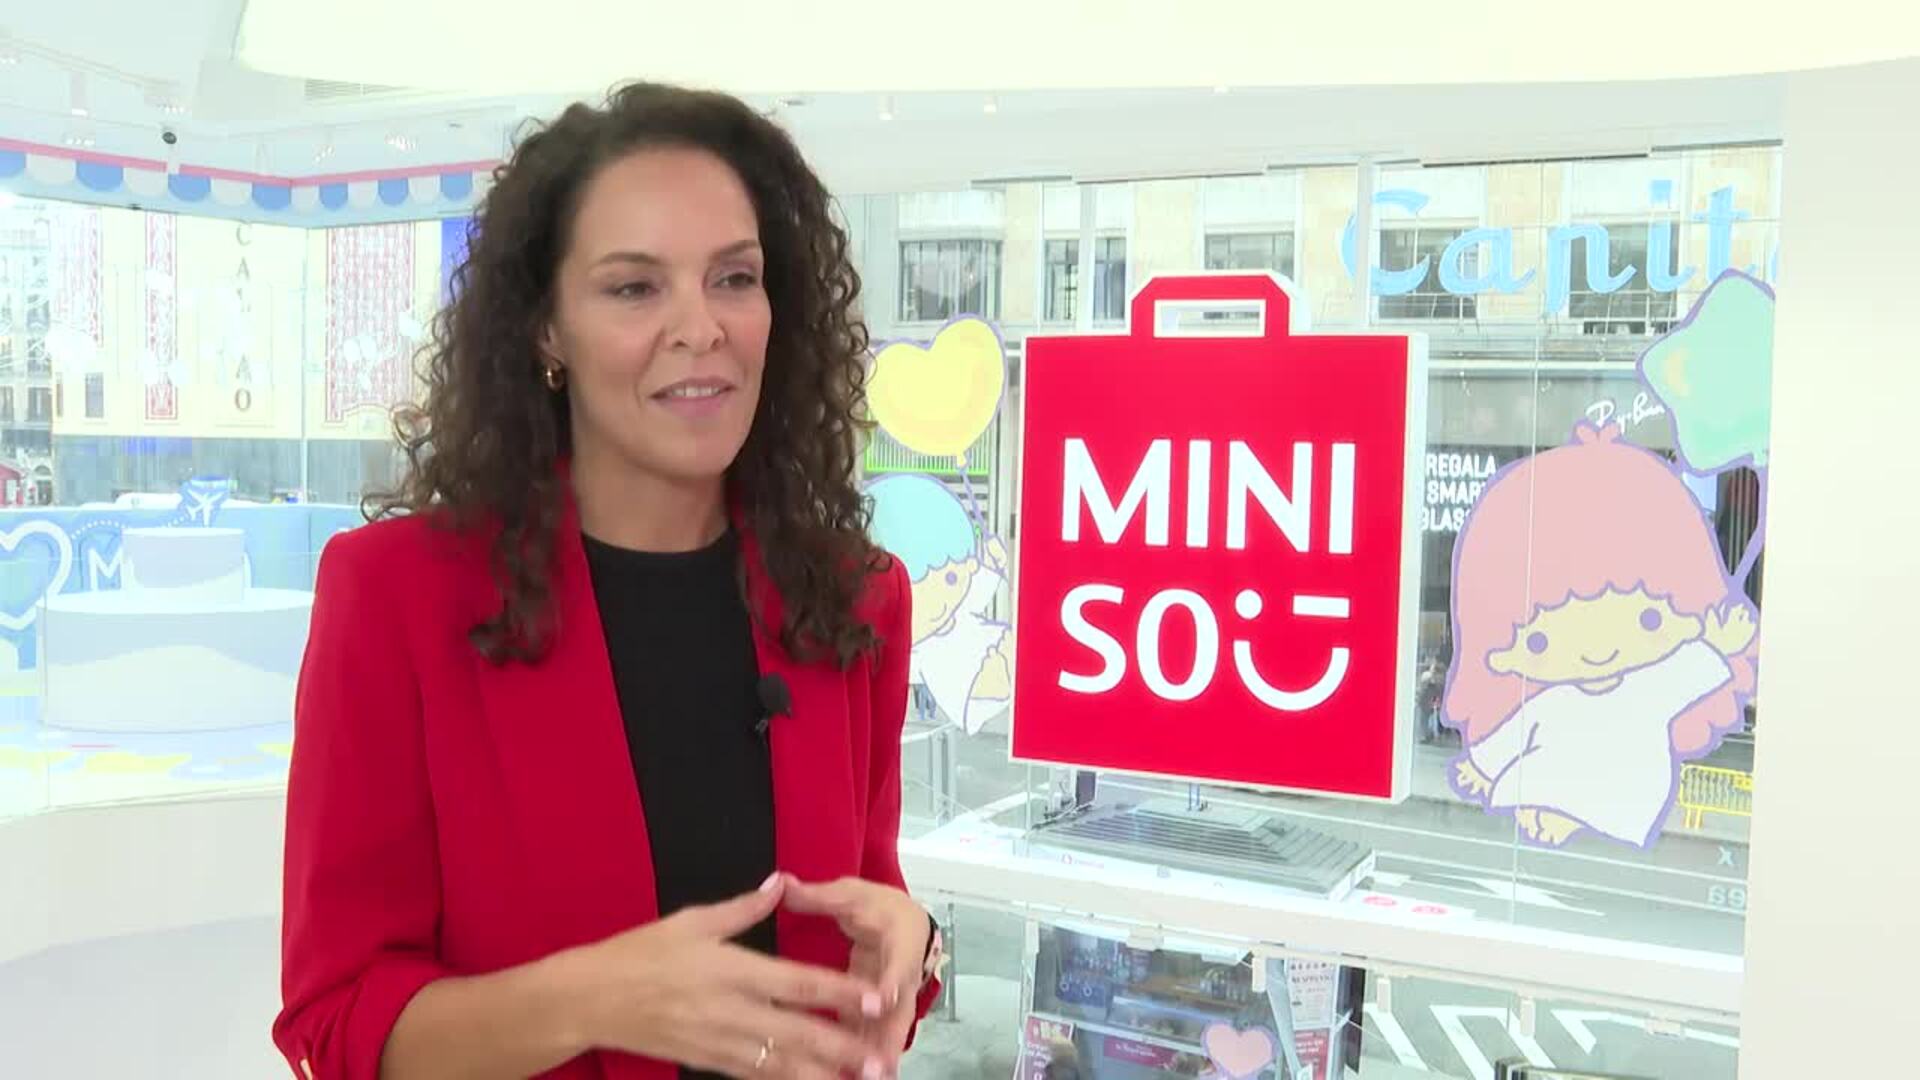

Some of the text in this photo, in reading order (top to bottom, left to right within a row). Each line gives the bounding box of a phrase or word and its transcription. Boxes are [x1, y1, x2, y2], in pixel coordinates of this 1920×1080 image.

[1341, 180, 1778, 313] Capit
[1061, 438, 1356, 554] MINI
[1425, 479, 1486, 505] SMAR
[1426, 452, 1496, 478] REGALA
